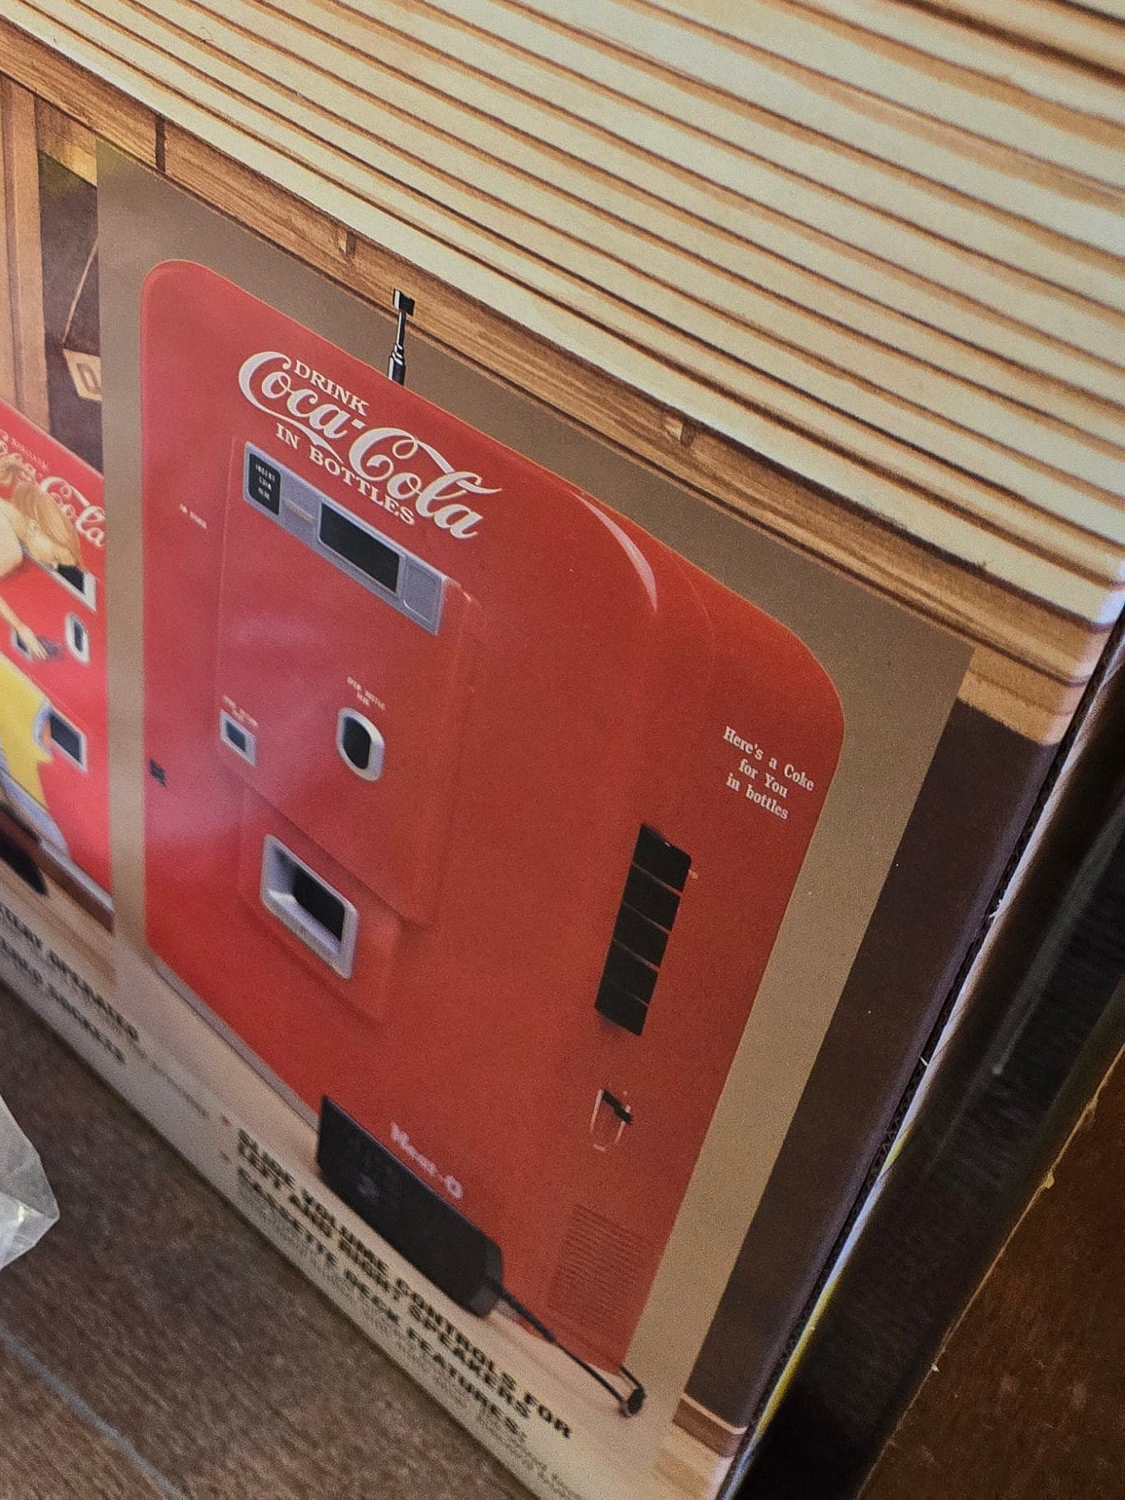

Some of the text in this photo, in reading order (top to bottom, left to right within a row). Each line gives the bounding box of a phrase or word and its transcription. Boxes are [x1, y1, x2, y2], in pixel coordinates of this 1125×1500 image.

[293, 358, 371, 417] DRINK
[238, 350, 503, 540] Coca-Cola
[275, 421, 416, 527] IN BOTTLES
[722, 725, 815, 792] Here's a Coke
[725, 771, 789, 820] in bottles
[738, 758, 789, 799] for You
[236, 1166, 528, 1439] CASSETTE DECK FEATURES:
[300, 1187, 391, 1279] VOLUME
[394, 1276, 518, 1392] CONTROLS
[523, 1390, 573, 1439] FOR
[407, 1301, 531, 1420] SPEAKERS
